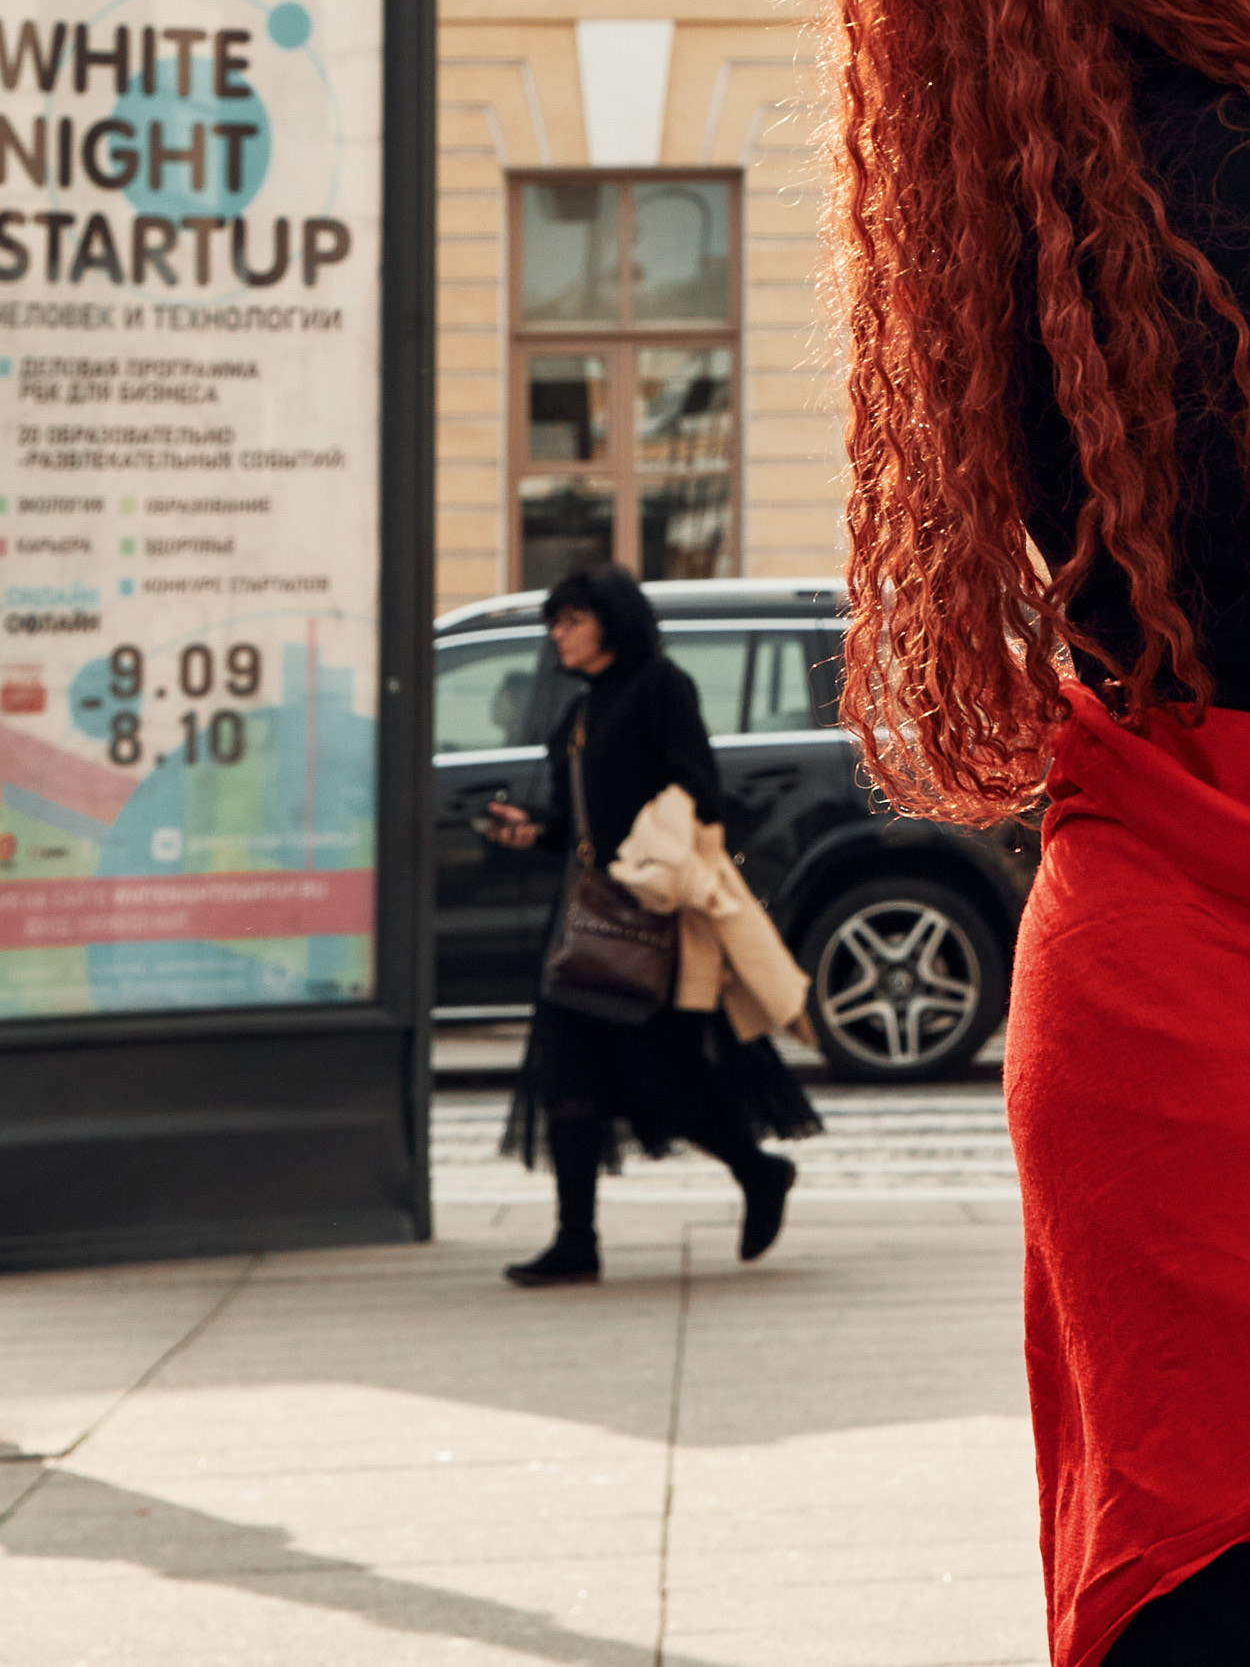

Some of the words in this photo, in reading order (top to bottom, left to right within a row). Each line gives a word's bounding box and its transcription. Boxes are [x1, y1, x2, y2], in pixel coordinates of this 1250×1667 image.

[0, 20, 252, 97] WHITE
[0, 114, 259, 193] NIGHT
[0, 210, 351, 288] STARTUP
[124, 306, 144, 330] И
[155, 305, 344, 332] ТЕХНОЛОГИИ
